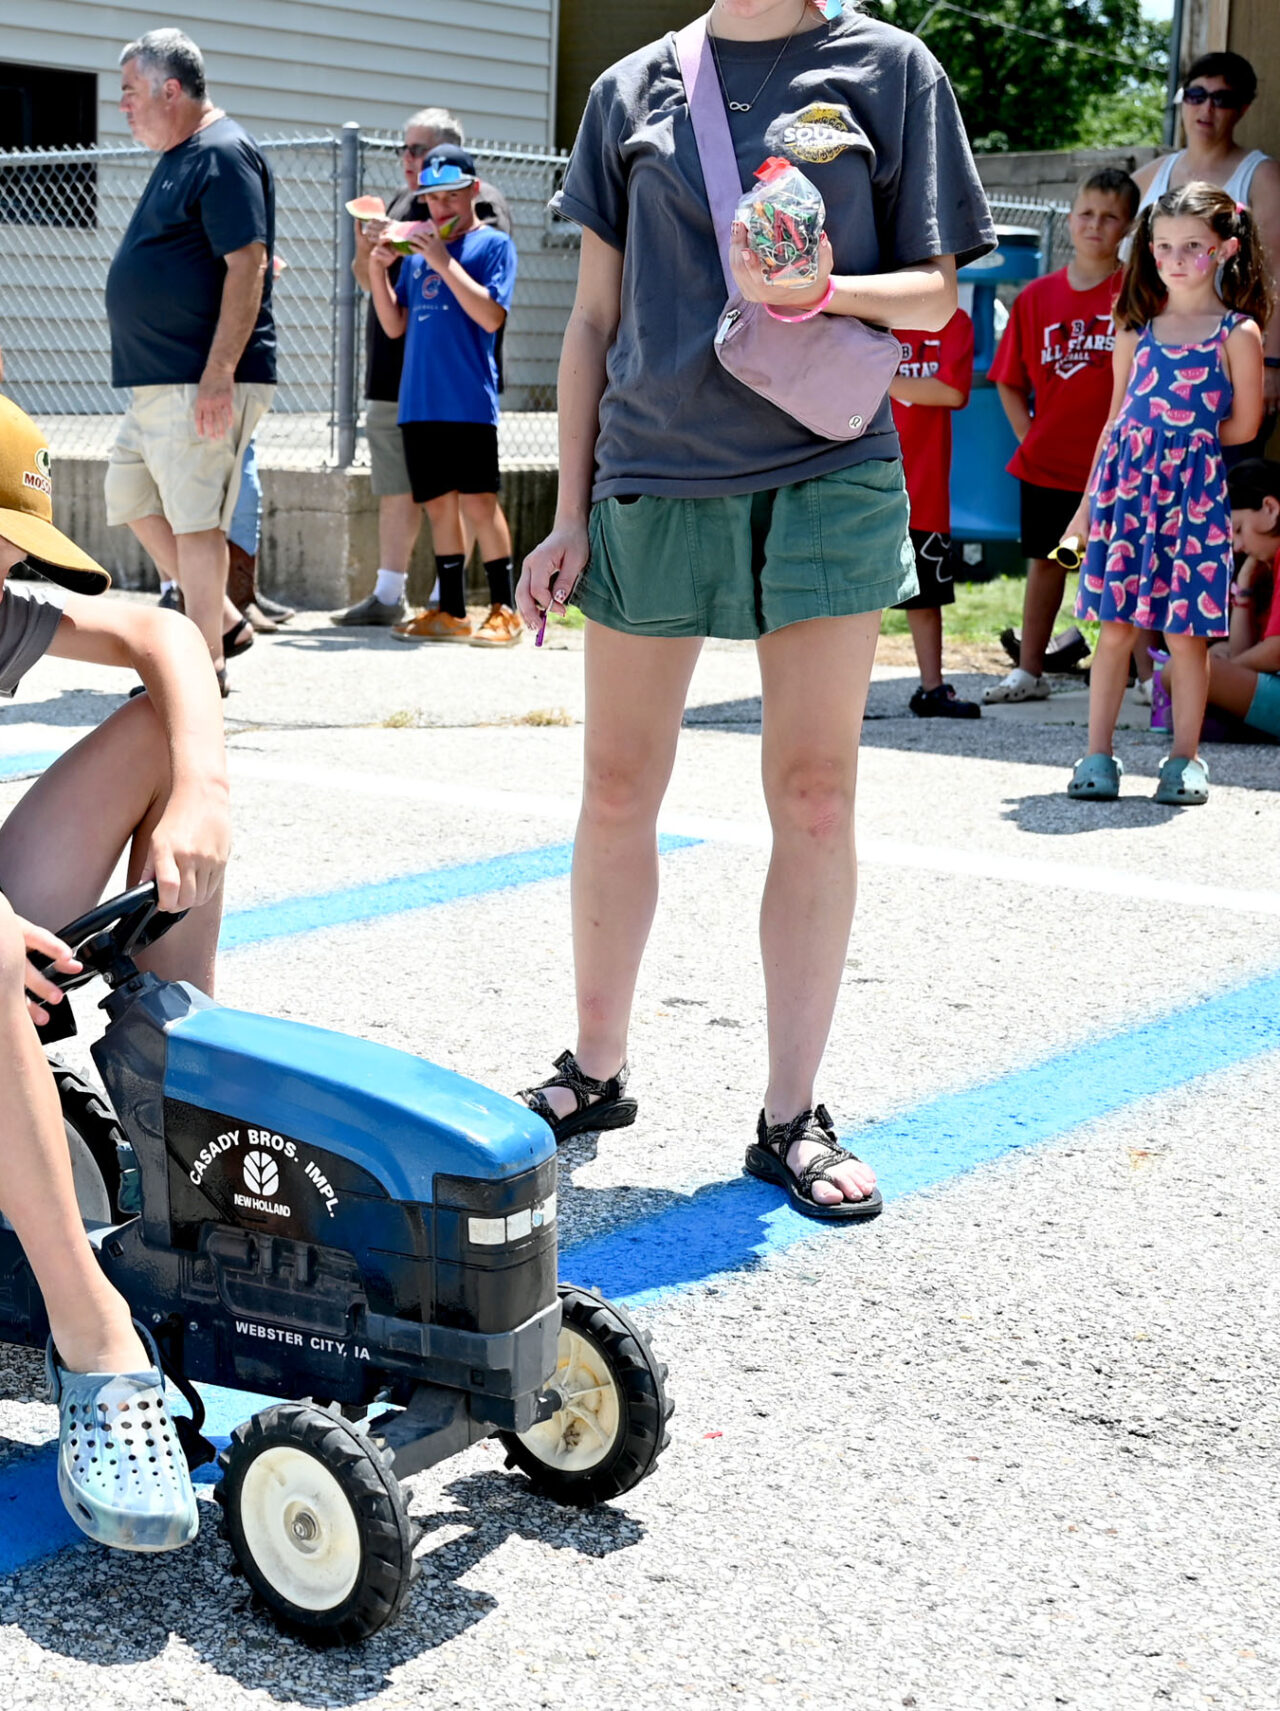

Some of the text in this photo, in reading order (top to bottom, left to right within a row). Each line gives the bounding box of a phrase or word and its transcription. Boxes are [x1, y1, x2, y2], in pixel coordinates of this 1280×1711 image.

[189, 1129, 339, 1218] CASADY BROS. IMPL.
[234, 1193, 291, 1217] NEW HOLLAND
[235, 1321, 371, 1361] WEBSTER CITY, IA
